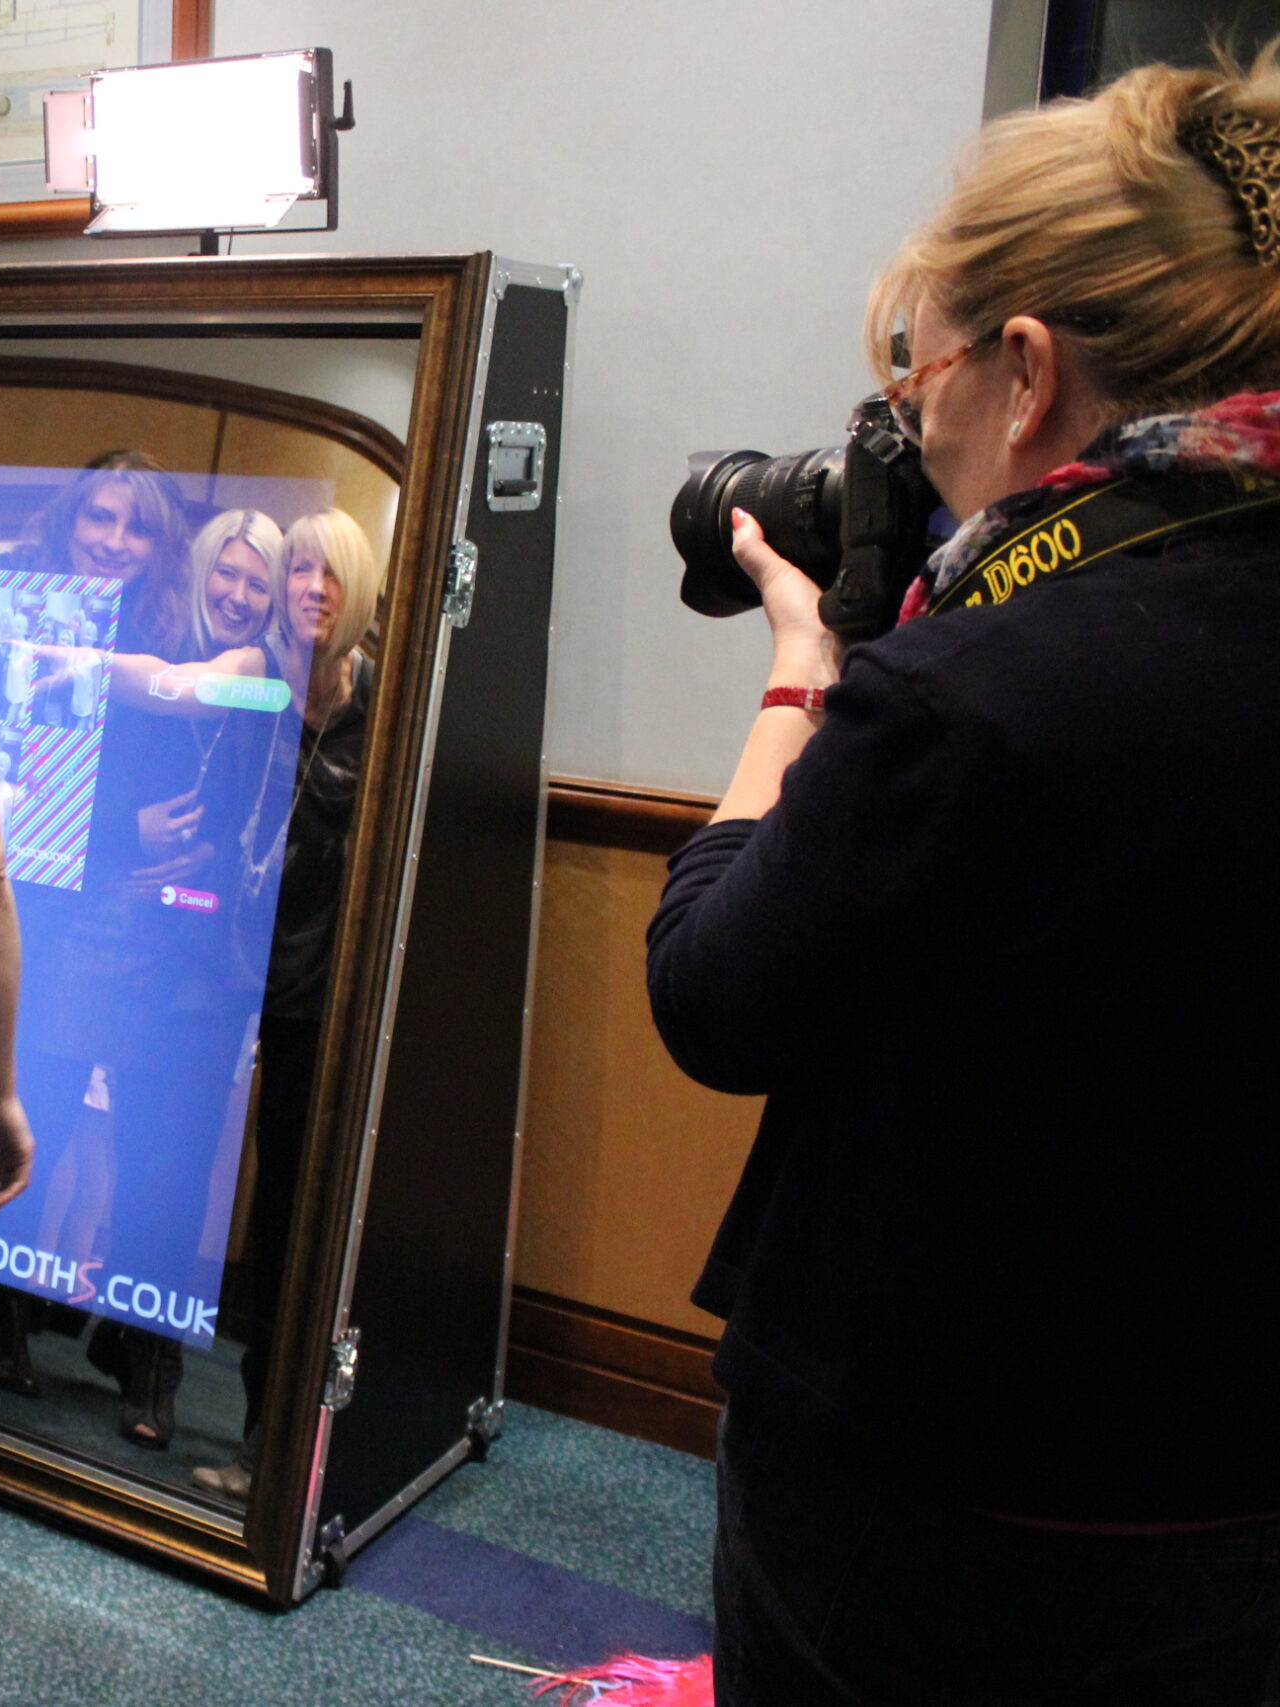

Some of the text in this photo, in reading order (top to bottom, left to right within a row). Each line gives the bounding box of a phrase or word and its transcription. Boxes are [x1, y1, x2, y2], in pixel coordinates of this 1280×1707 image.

[983, 518, 1082, 605] D600
[231, 682, 281, 702] PRINT
[179, 892, 214, 909] Cancel
